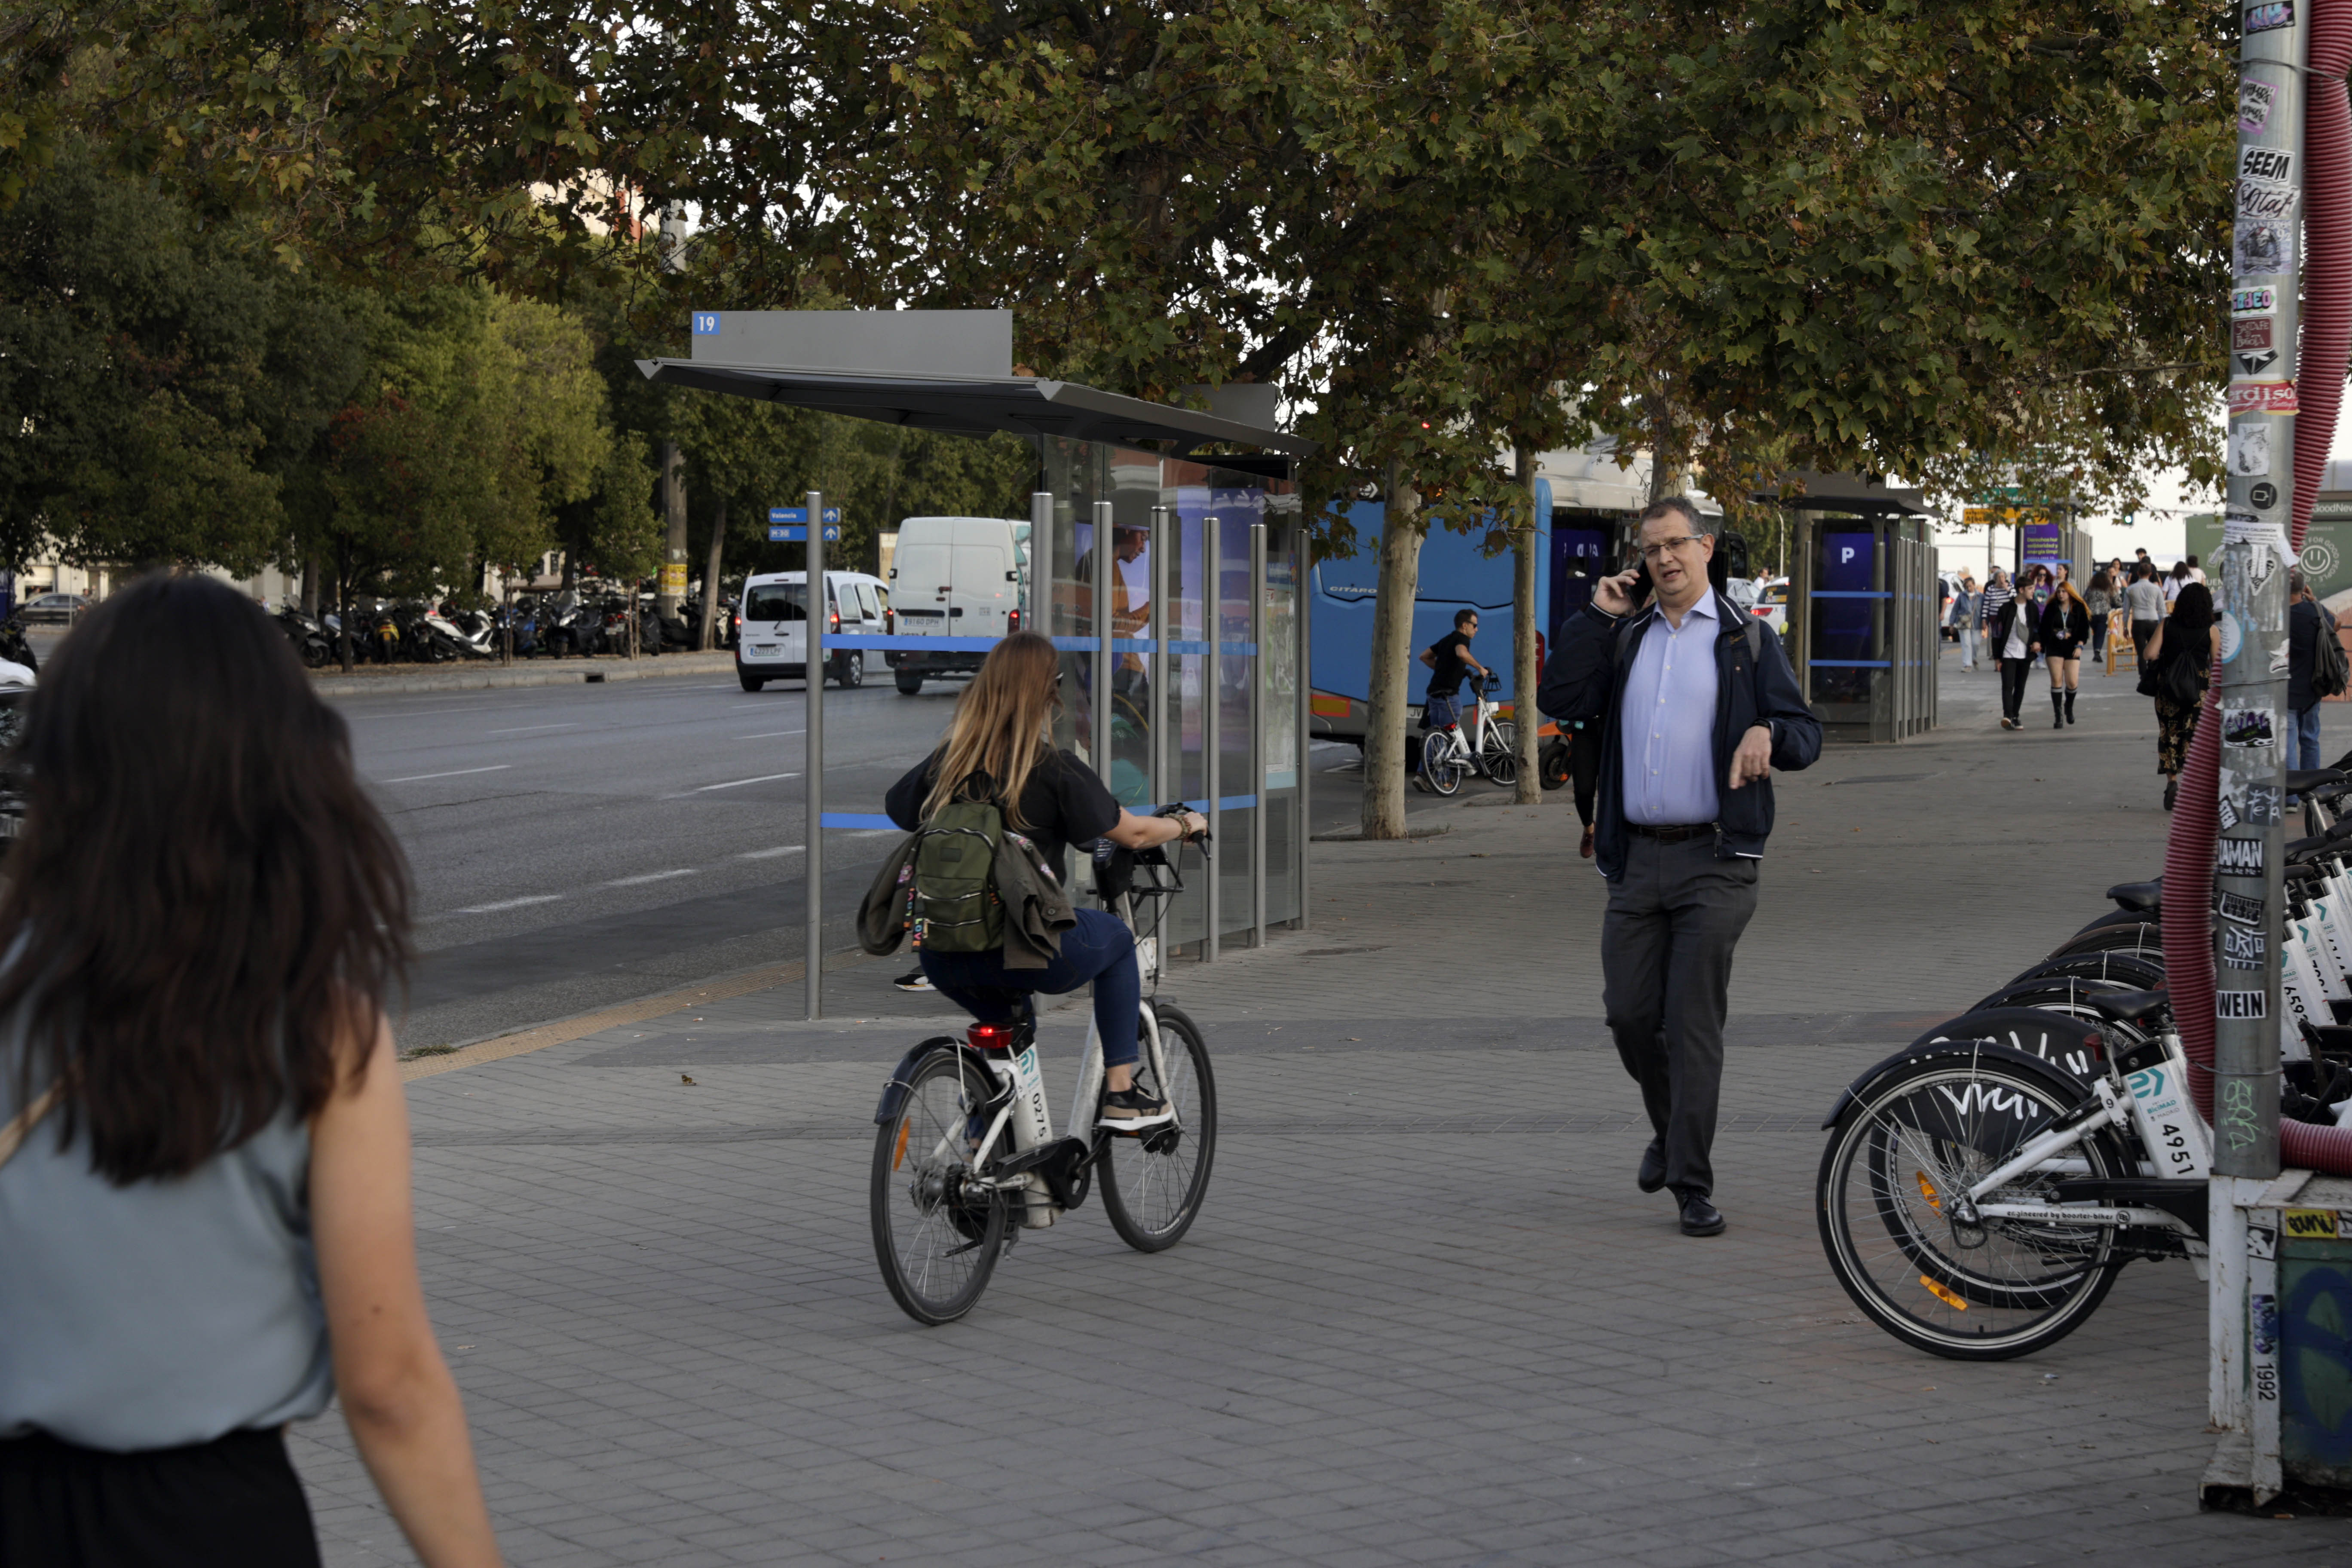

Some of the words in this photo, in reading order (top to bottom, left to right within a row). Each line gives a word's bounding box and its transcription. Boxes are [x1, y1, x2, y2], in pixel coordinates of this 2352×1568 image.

[698, 316, 714, 331] 19
[1842, 548, 1854, 563] P
[2218, 992, 2263, 1017] WEIN
[2106, 1099, 2114, 1108] 9
[2147, 1099, 2176, 1114] BiciMAD
[1033, 1093, 1047, 1137] 0275
[2157, 1107, 2180, 1118] MADRID
[2163, 1124, 2195, 1174] 4951
[2256, 1363, 2276, 1401] 1992
